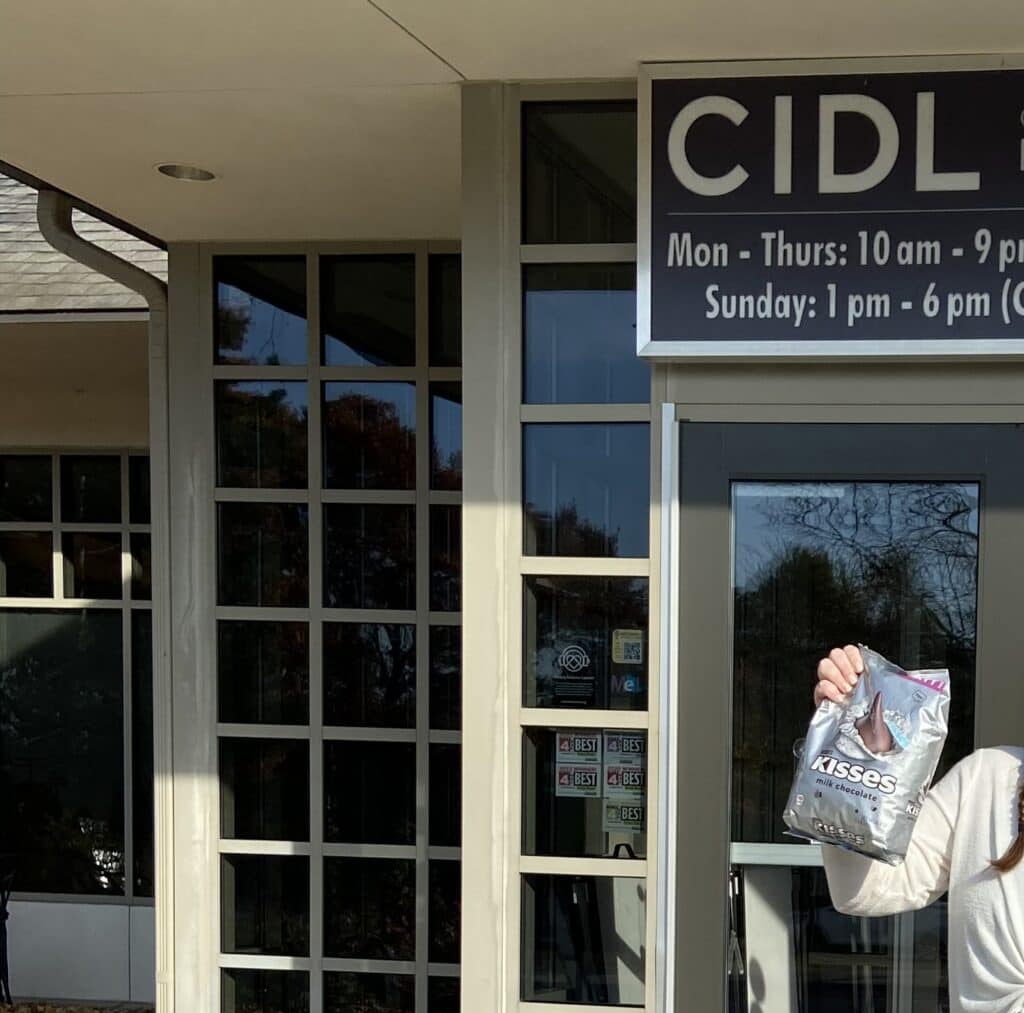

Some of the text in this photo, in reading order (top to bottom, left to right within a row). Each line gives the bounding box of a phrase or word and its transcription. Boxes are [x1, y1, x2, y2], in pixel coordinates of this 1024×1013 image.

[667, 91, 980, 197] CIDL
[667, 232, 728, 267] Mon
[761, 230, 847, 267] Thurs:
[858, 230, 890, 265] 10
[897, 239, 941, 265] am
[974, 228, 992, 263] 9
[705, 282, 816, 326] Sunday:
[827, 284, 837, 317] 1
[847, 292, 890, 326] pm
[923, 282, 940, 317] 6
[947, 292, 990, 325] pm
[574, 738, 597, 752] BEST
[623, 738, 645, 752] BEST
[574, 772, 597, 785] BEST
[623, 772, 645, 785] BEST
[816, 778, 878, 802] milk chocolate
